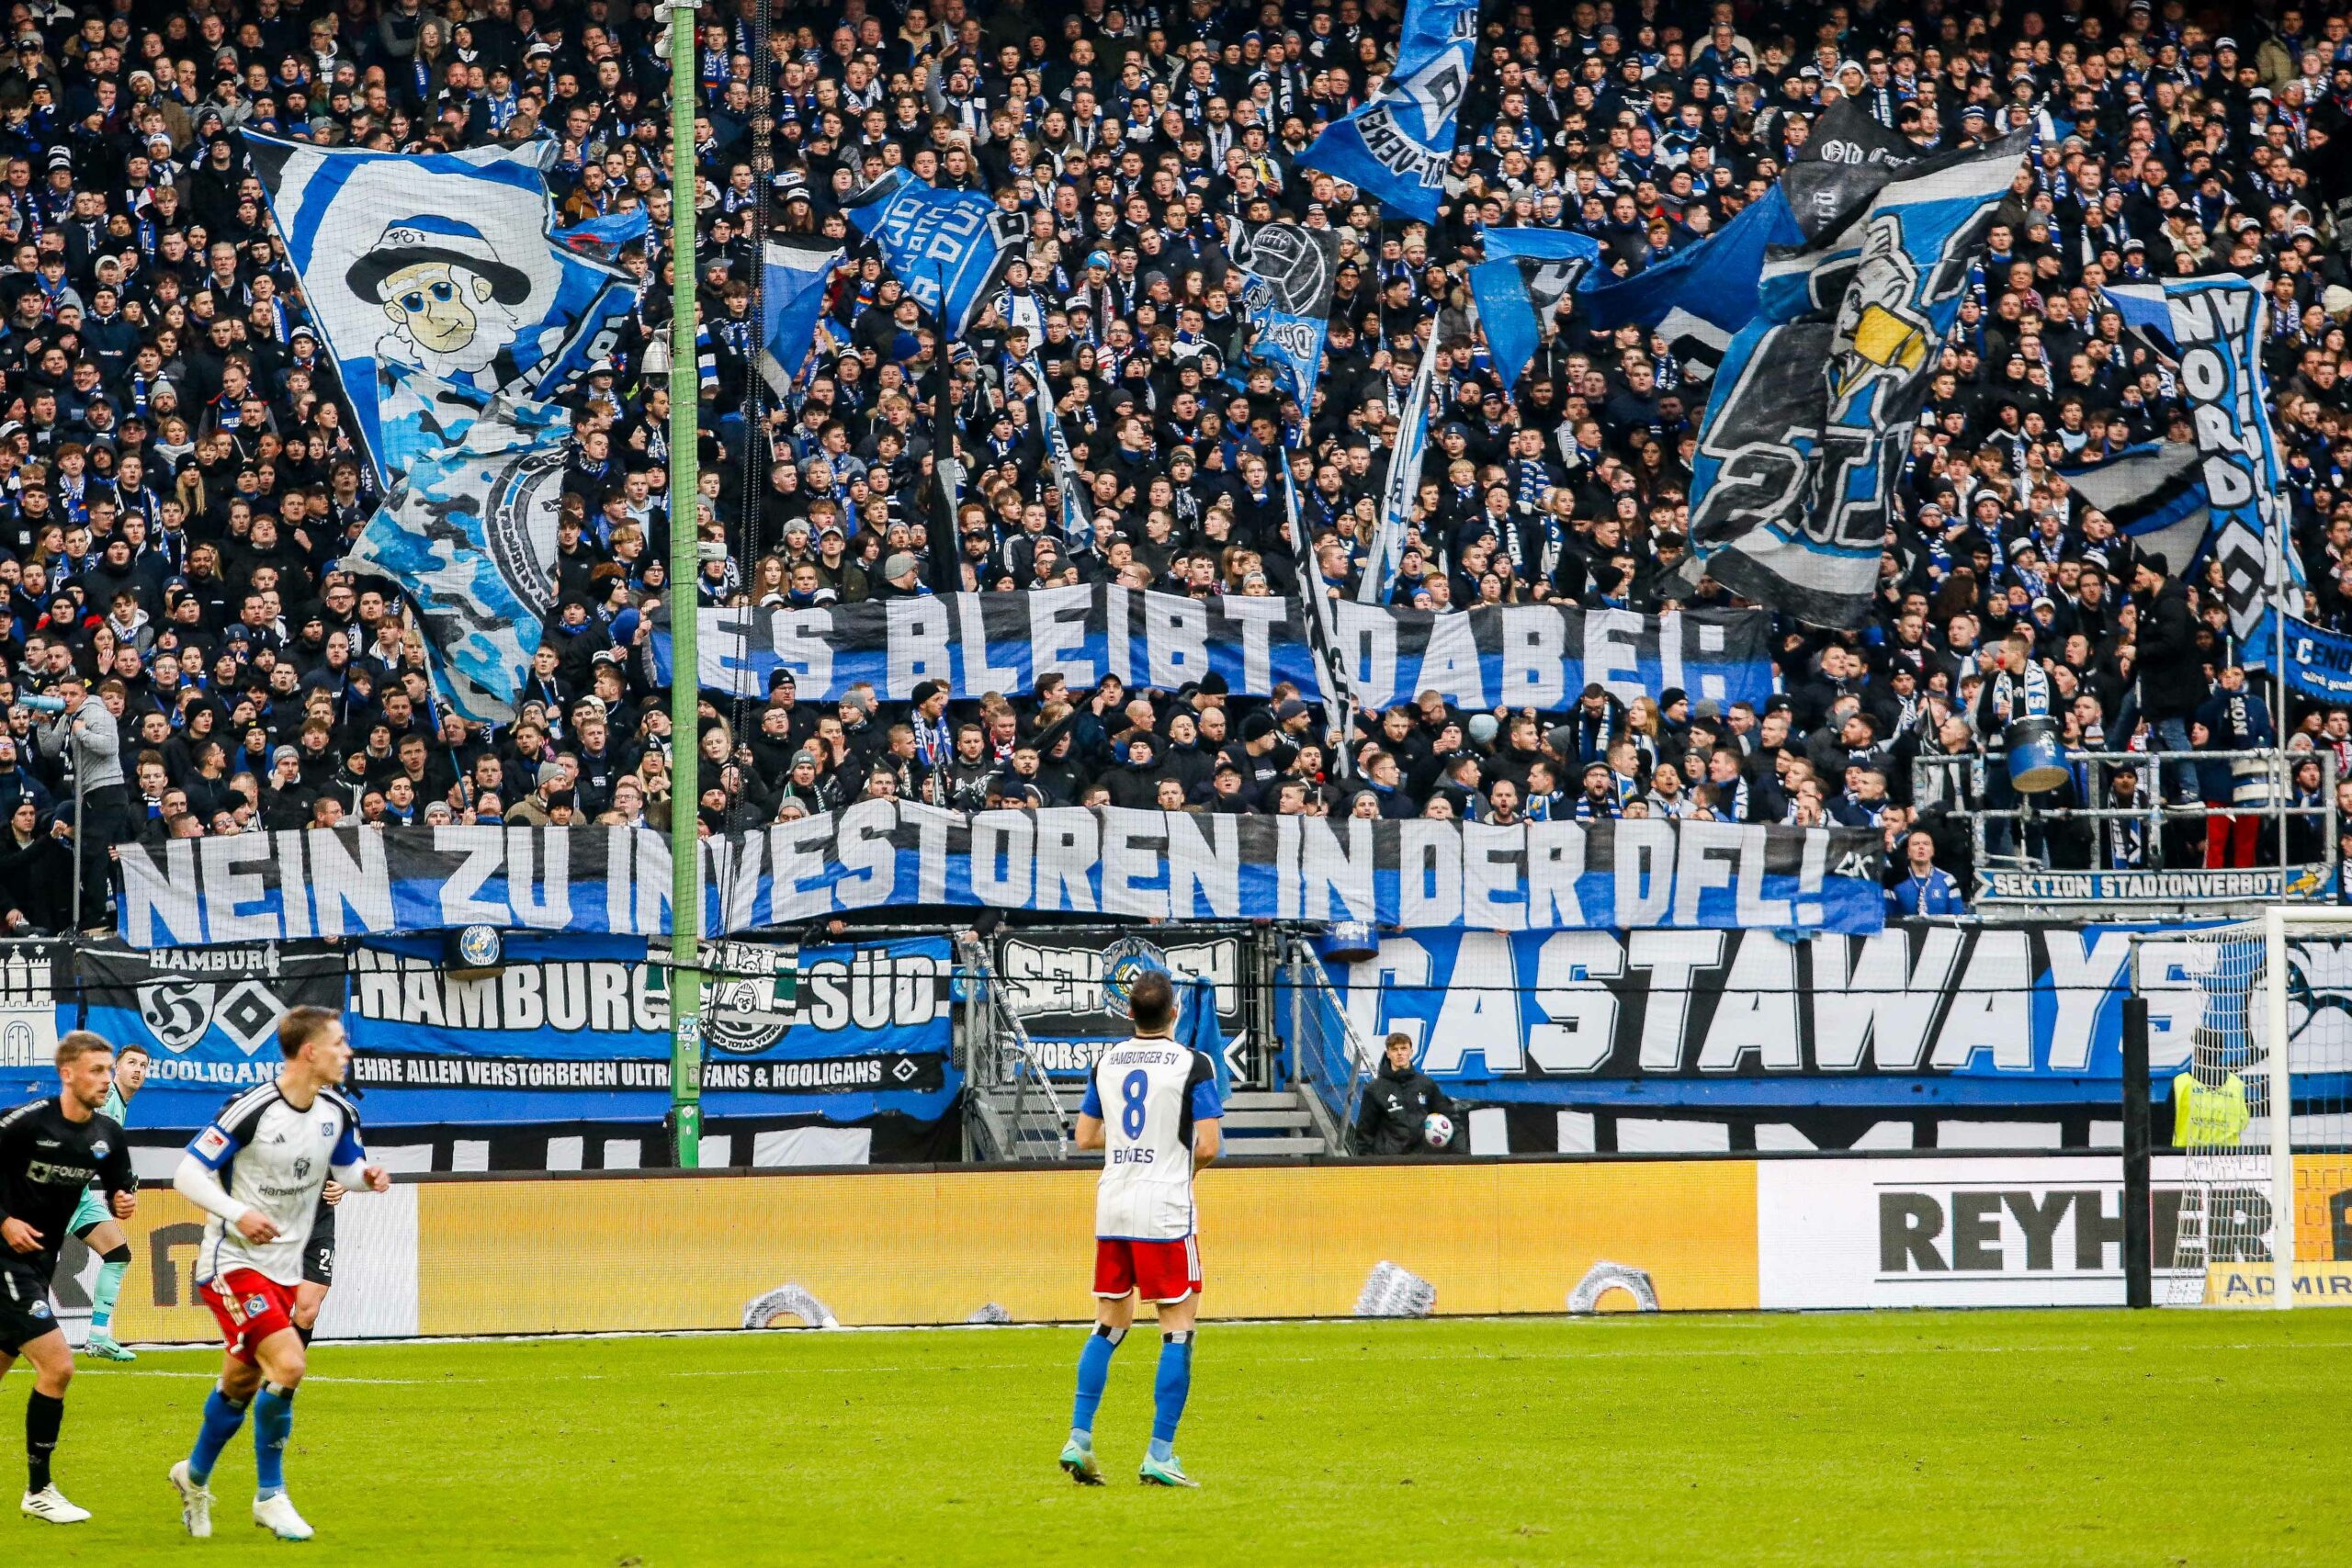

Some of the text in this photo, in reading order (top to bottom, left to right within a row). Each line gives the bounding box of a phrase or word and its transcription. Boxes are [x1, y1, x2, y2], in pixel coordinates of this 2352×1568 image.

[2167, 290, 2253, 508] NORD
[697, 605, 834, 701] ES
[886, 582, 1288, 698] BLEIBT
[1336, 598, 1725, 711] DABEI:
[116, 799, 1829, 948] NEIN ZU INVESTOREN IN DER DFL!
[1992, 873, 2280, 898] SEKTION STADIONVERBOT
[809, 949, 936, 1031] SÜD
[1346, 928, 2216, 1073] CASTAWAYS
[146, 1058, 285, 1084] HOOLIGANS
[354, 1057, 882, 1088] EHRE ALLEN VERSTORBENEN ULTR FANS & HOOLIGANS
[1109, 1051, 1179, 1066] HAMBURGER SV
[1122, 1068, 1148, 1141] 8
[1879, 1190, 2273, 1272] REYHER
